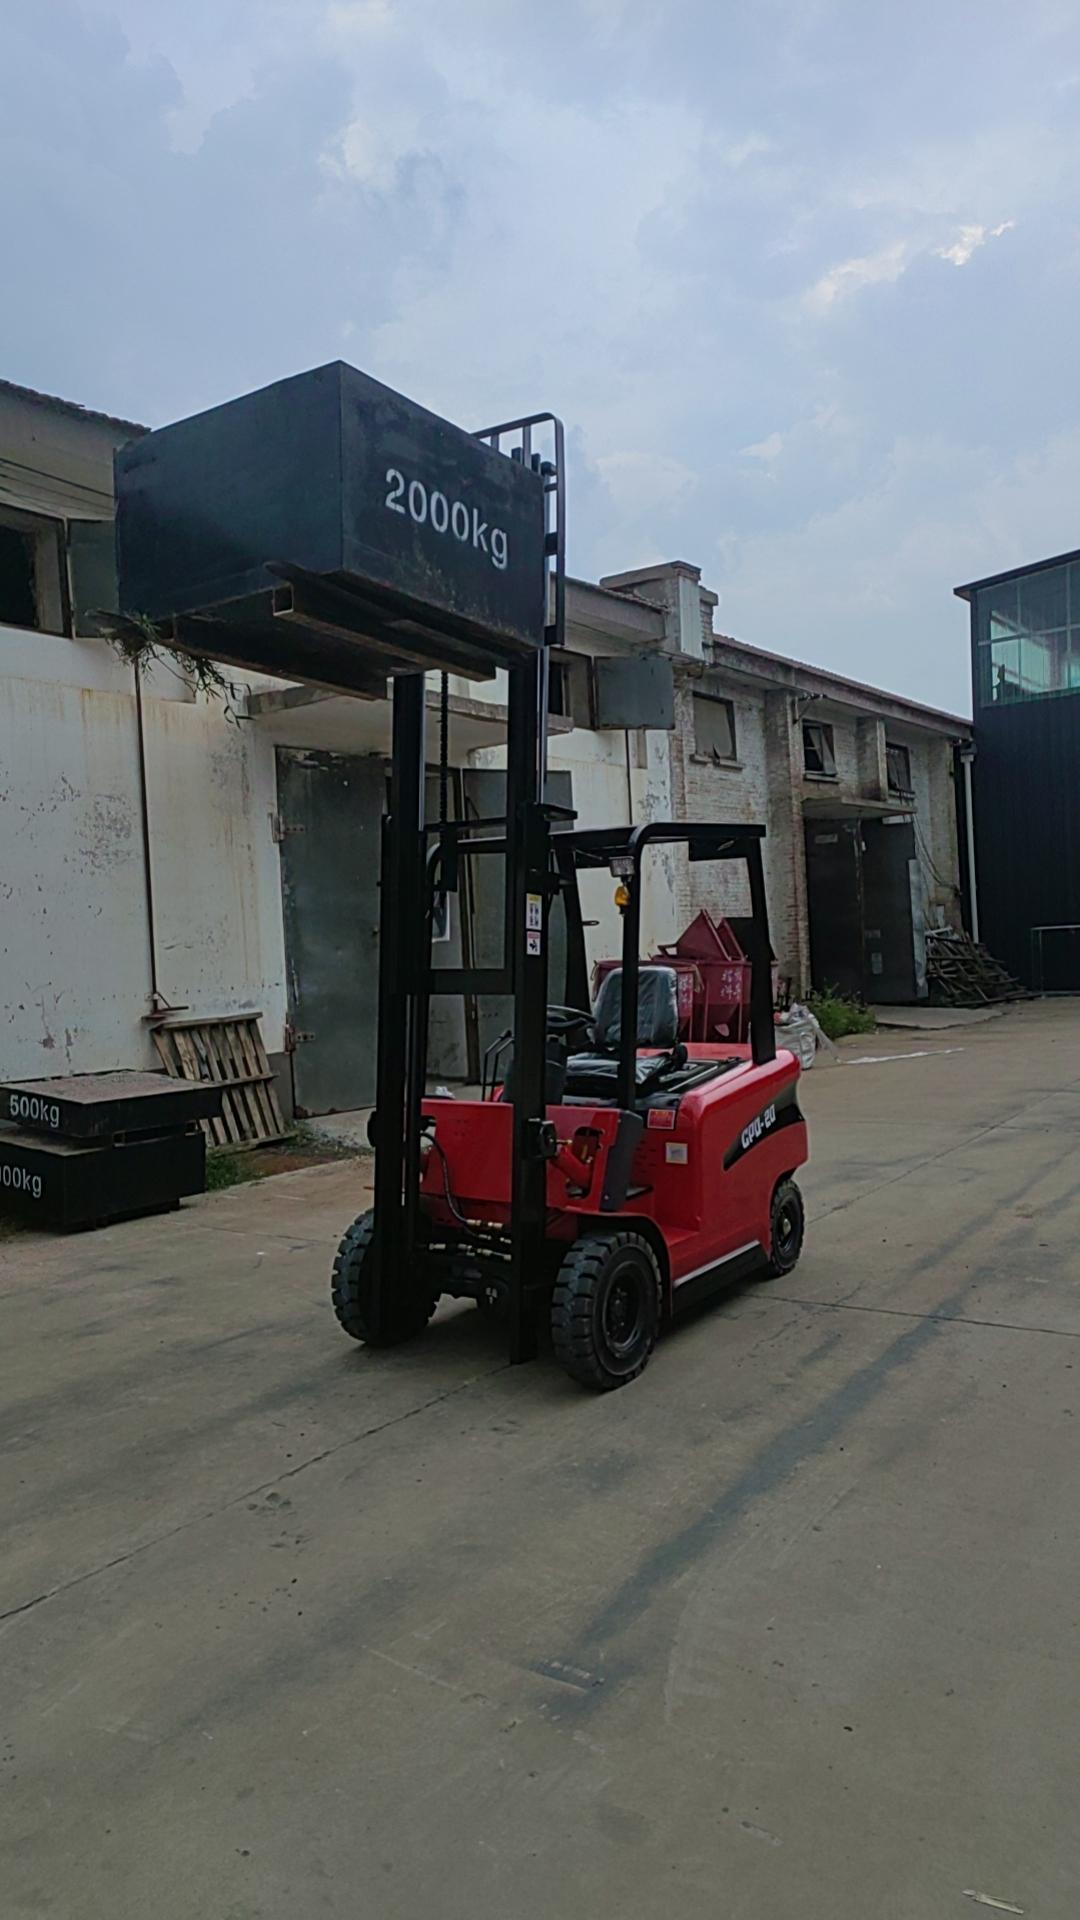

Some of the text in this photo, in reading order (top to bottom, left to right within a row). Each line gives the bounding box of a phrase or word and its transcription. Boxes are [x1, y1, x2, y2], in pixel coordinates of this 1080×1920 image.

[385, 468, 508, 570] 2000kg
[10, 1094, 60, 1128] 500kg
[0, 1164, 42, 1198] 00kg
